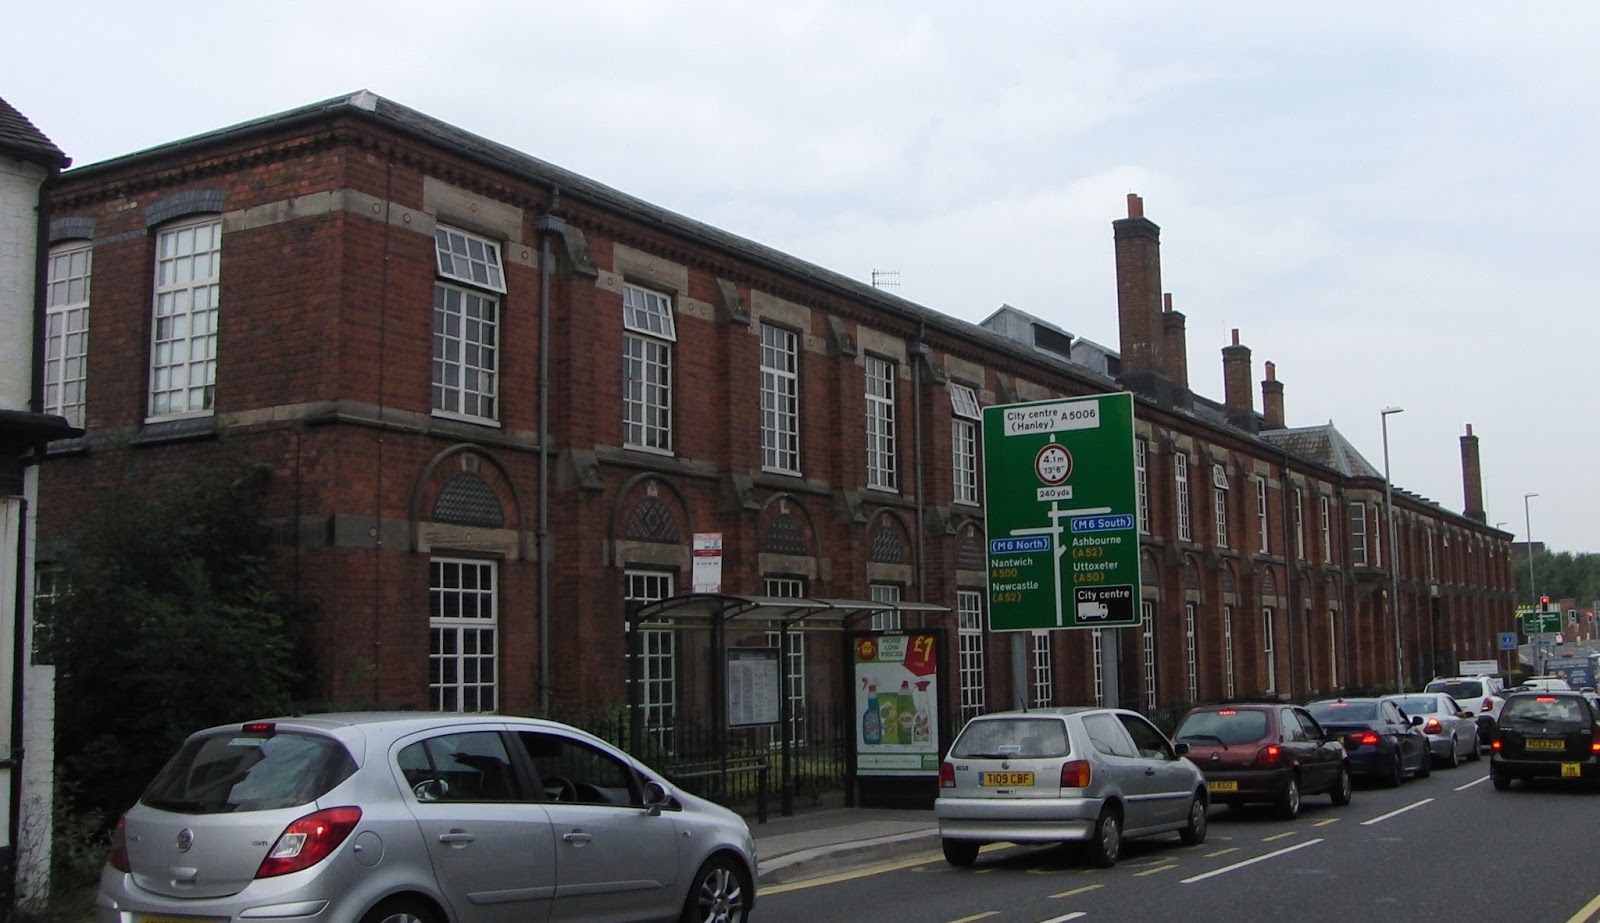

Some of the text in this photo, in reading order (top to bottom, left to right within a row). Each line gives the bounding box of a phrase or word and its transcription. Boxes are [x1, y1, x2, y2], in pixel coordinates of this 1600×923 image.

[1007, 408, 1058, 421] City centre
[1061, 409, 1096, 421] A5006
[1012, 419, 1054, 432] (Hanley)
[1040, 488, 1070, 498] 240 yds
[1098, 516, 1132, 528] South)
[1016, 539, 1048, 550] North)
[1072, 536, 1122, 546] Ashbourne
[1072, 547, 1102, 558] (A52)
[992, 558, 1033, 568] Nantwich
[1073, 561, 1118, 572] Uttoxeter
[992, 568, 1018, 578] A500
[1073, 572, 1104, 582] (A50)
[992, 581, 1038, 591] Newcastle
[992, 592, 1021, 602] (A52)
[1078, 590, 1130, 600] City centre
[914, 636, 933, 662] £1
[987, 772, 1029, 783] T109 CBF
